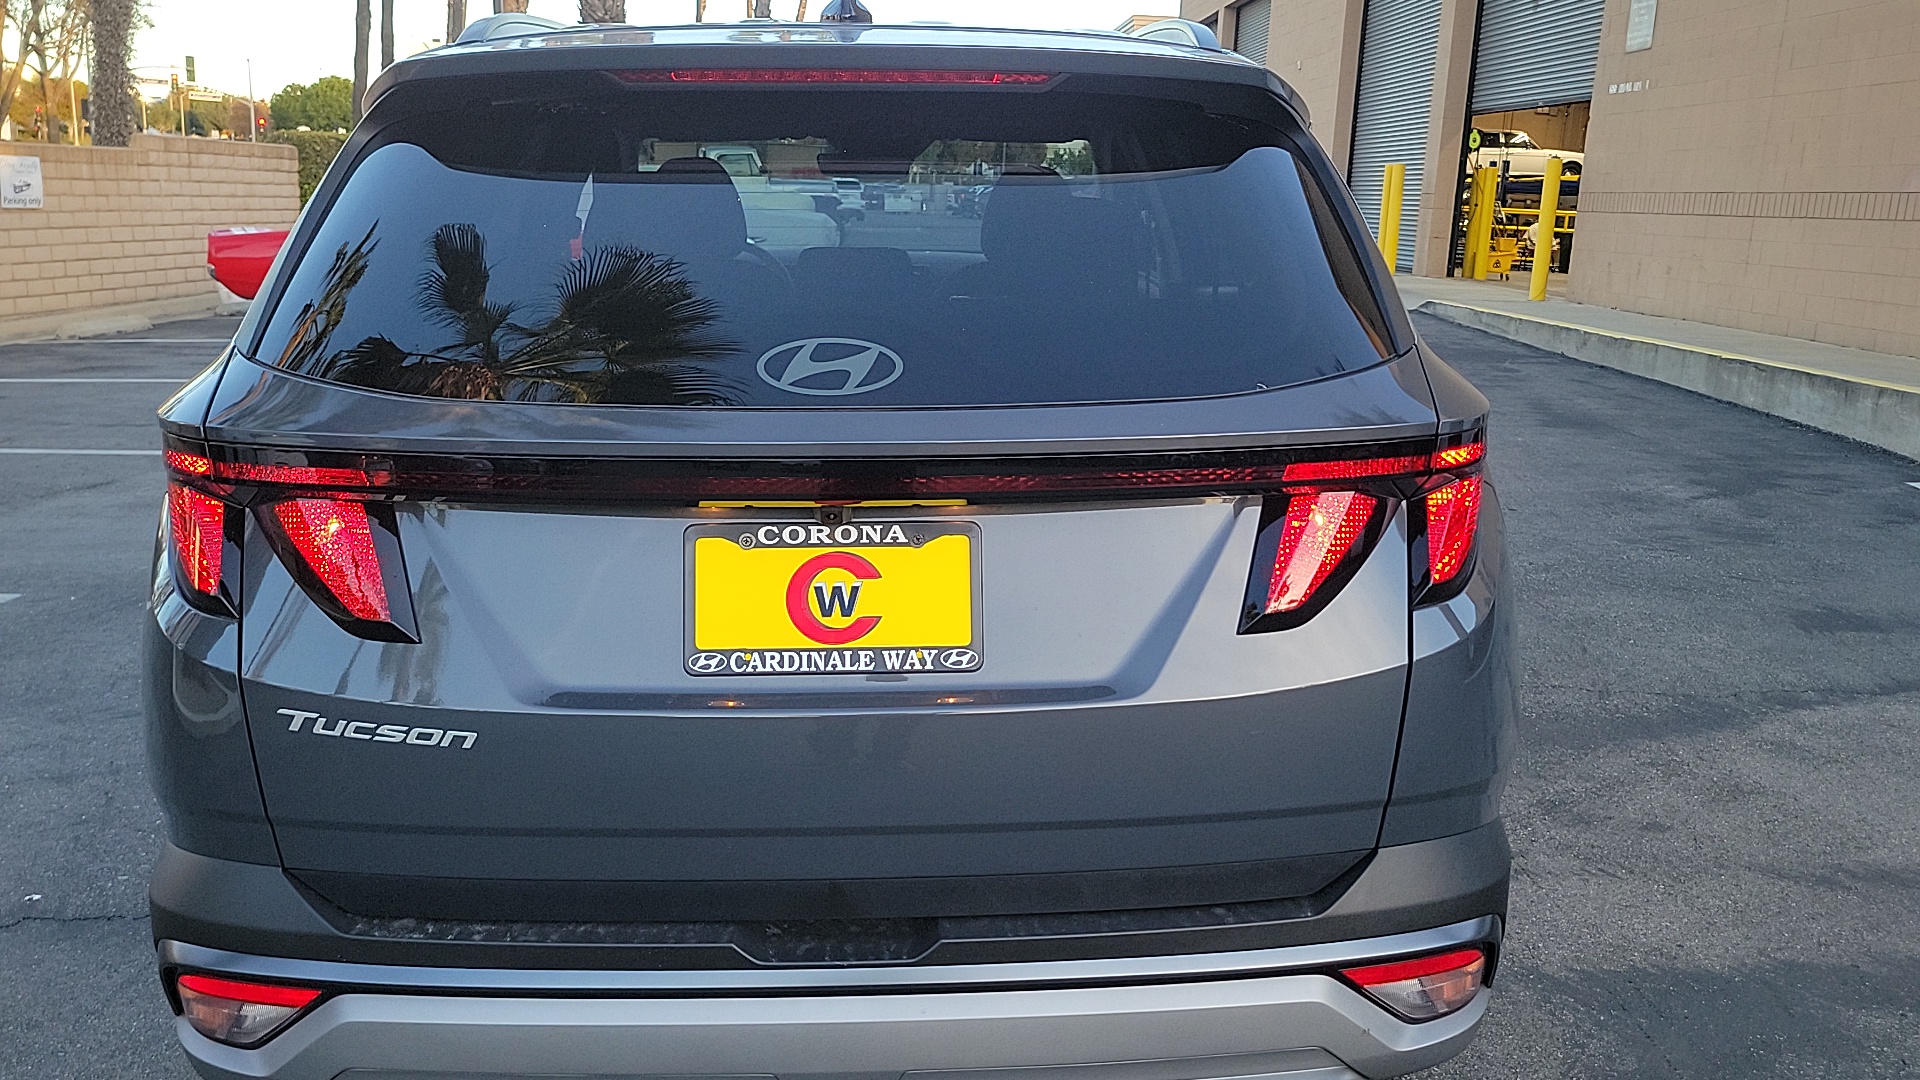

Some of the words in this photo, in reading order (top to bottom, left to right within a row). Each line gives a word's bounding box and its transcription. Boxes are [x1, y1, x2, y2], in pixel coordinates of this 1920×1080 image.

[3, 196, 28, 207] Parking
[28, 196, 41, 206] only
[757, 524, 909, 546] CORONA
[729, 650, 876, 674] CARDINALE
[879, 649, 939, 671] WAY
[276, 708, 478, 750] Tucson
